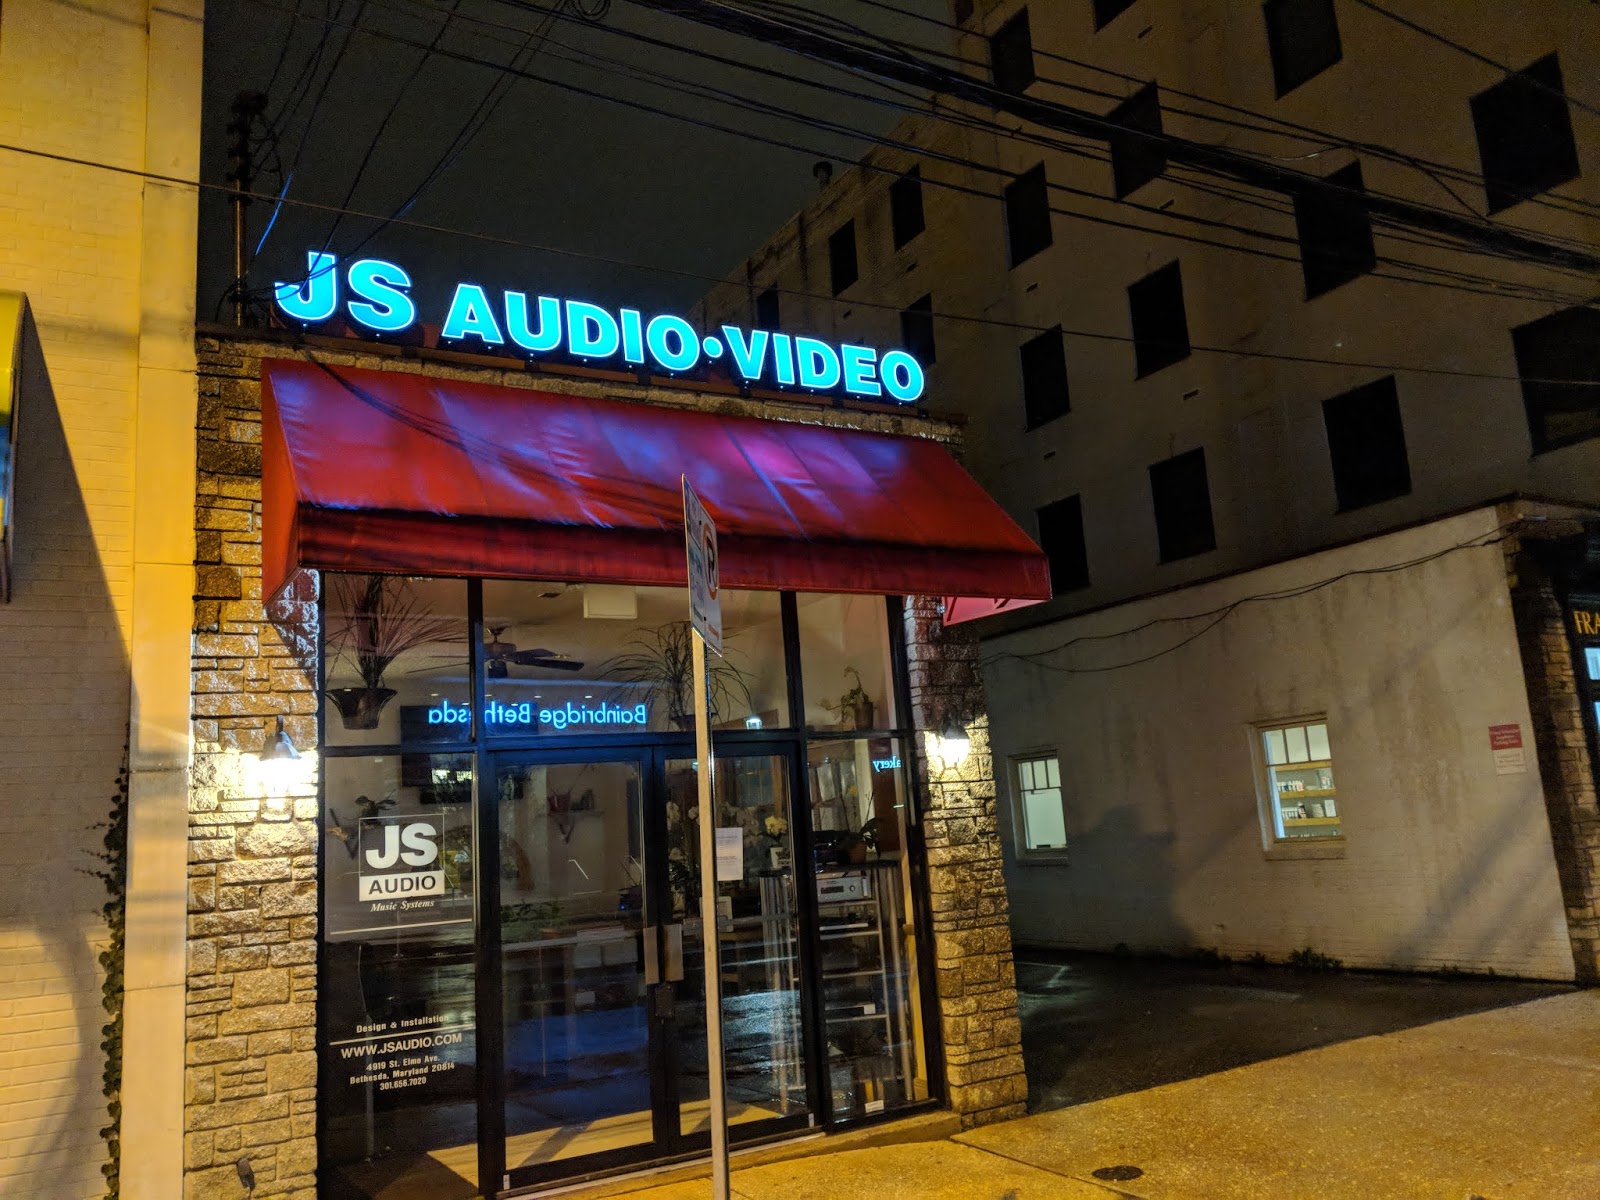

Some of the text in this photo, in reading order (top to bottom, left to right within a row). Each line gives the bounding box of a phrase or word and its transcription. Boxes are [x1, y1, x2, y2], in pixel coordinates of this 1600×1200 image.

[274, 250, 416, 332] JS
[365, 822, 438, 869] JS
[368, 875, 436, 895] AUDIO
[370, 900, 434, 912] Music Systems
[356, 1014, 449, 1034] Design & Installation
[340, 1033, 463, 1059] WWW.JSAUDIO.COM
[366, 1061, 386, 1071] 4919
[403, 1058, 421, 1067] Elmo
[392, 1066, 429, 1079] Maryland
[431, 1062, 455, 1072] 20814
